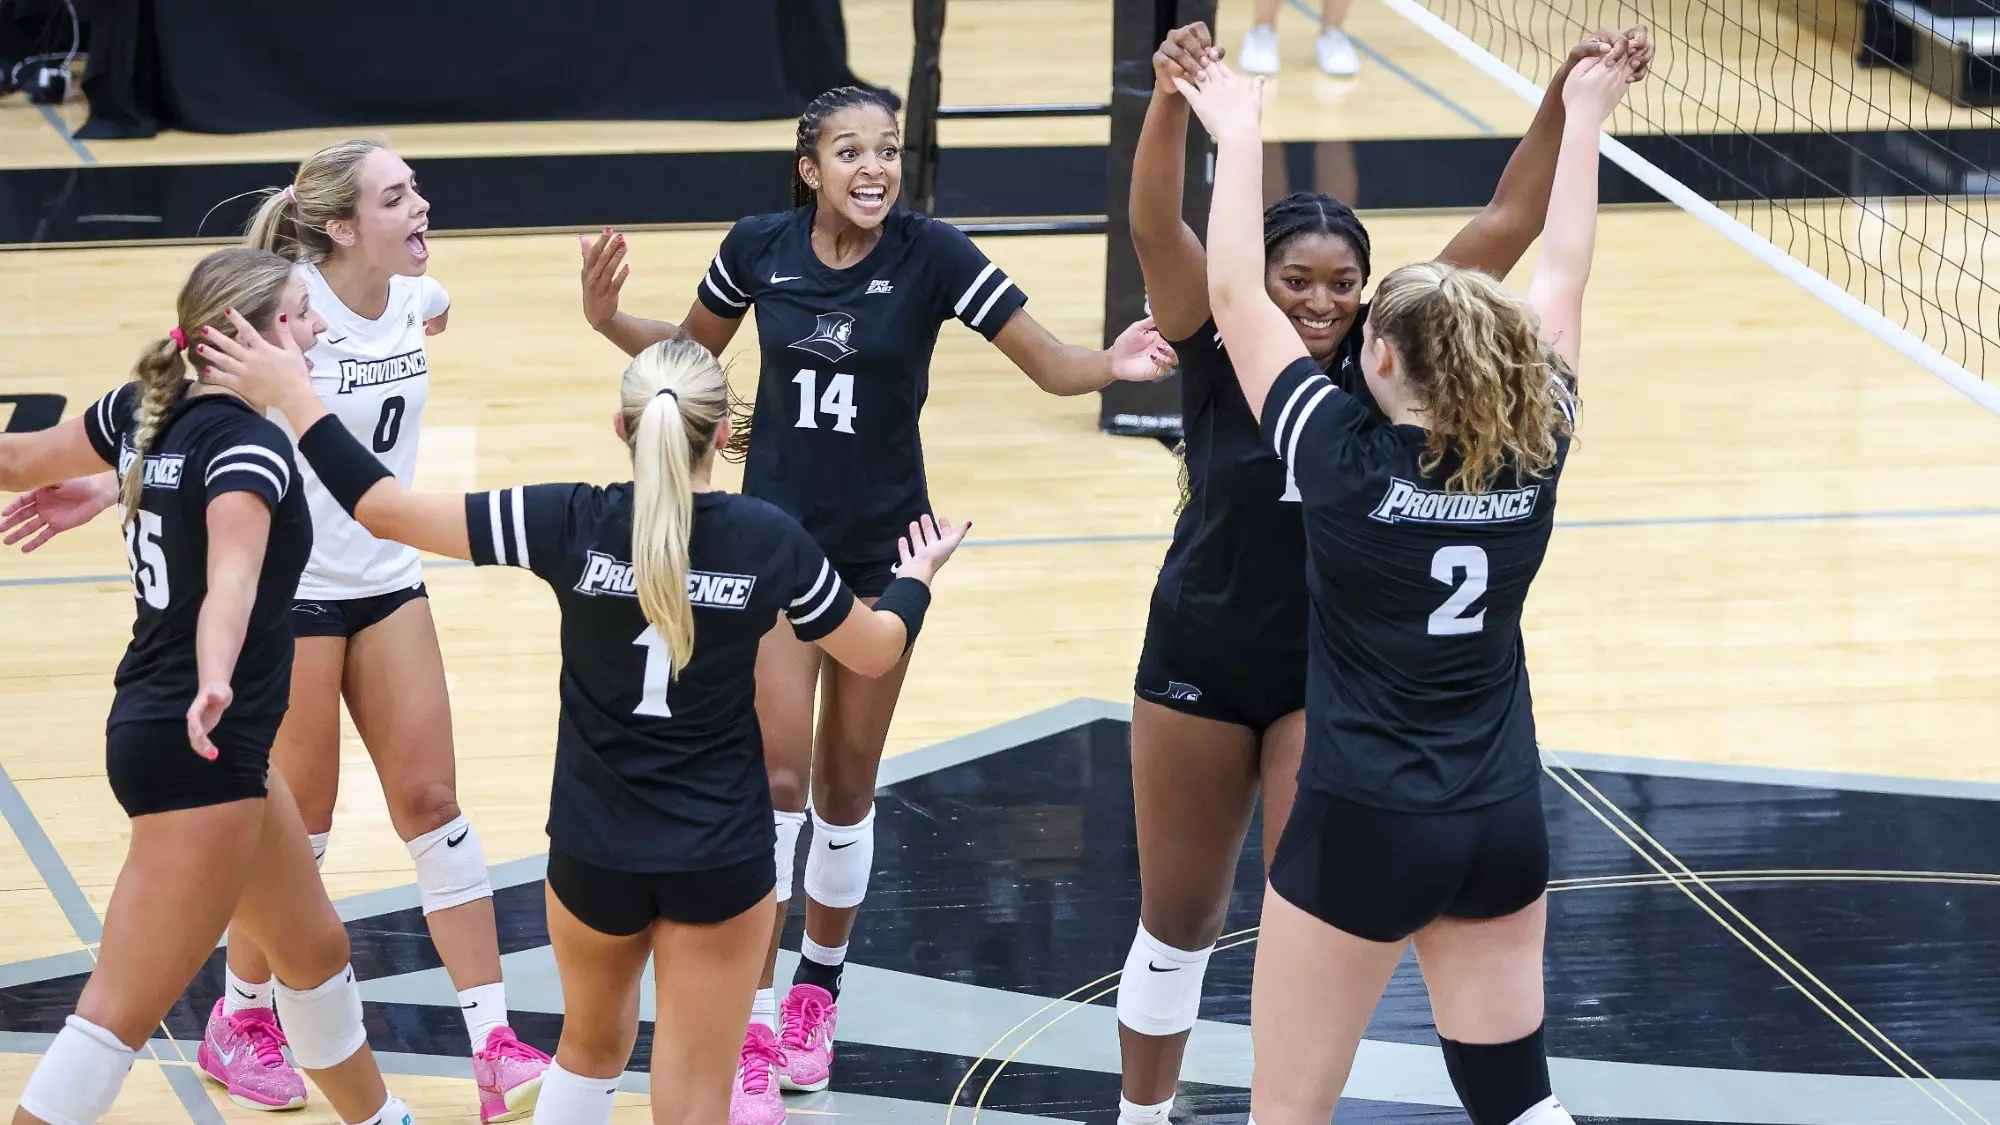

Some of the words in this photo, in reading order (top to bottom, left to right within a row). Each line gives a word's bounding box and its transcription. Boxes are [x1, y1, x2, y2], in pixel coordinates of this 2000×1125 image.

[372, 395, 406, 454] 0
[791, 368, 858, 435] 14
[1370, 478, 1540, 523] PROVIDENCE
[576, 552, 755, 608] PROENCE
[1427, 545, 1489, 636] 2
[632, 621, 673, 718] 1
